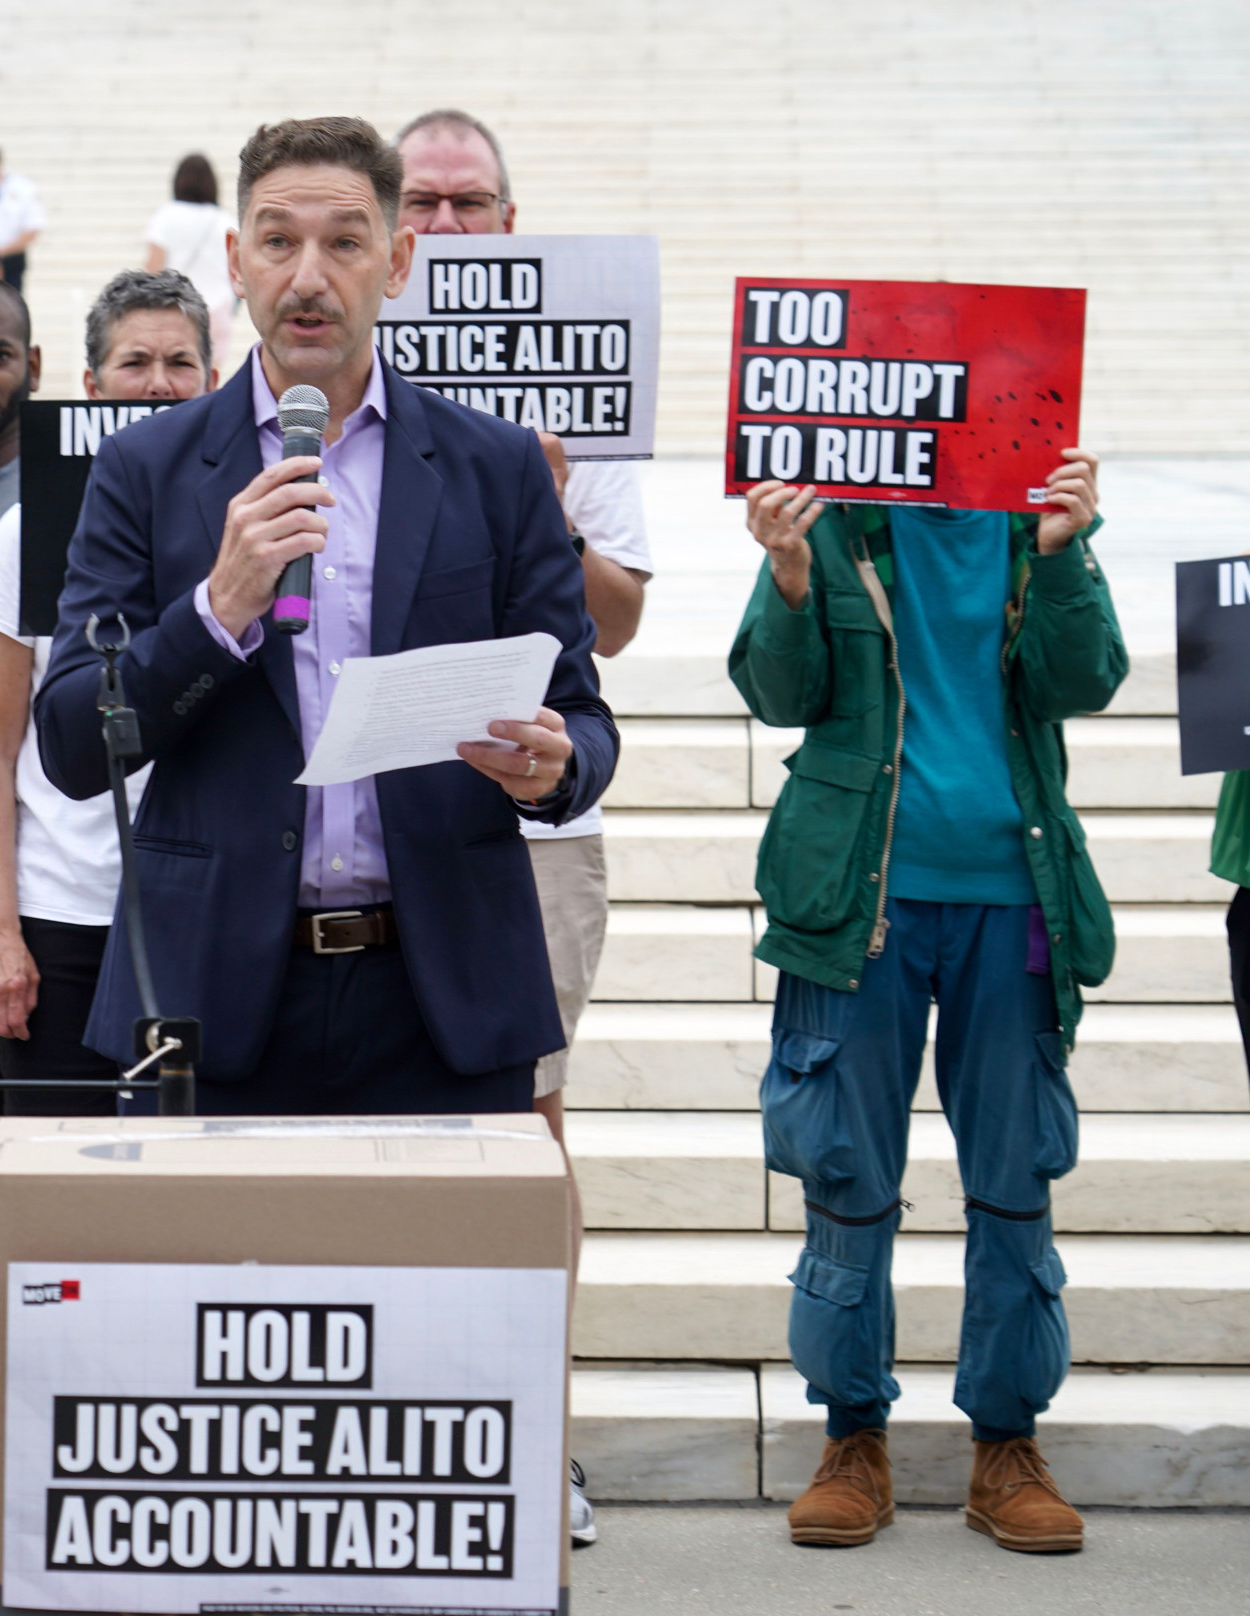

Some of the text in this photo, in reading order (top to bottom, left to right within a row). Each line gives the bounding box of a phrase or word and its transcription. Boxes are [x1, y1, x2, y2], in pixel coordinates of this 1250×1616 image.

[433, 263, 538, 310] HOLD
[372, 324, 626, 372] USTICE ALITO
[749, 290, 843, 346] TOO
[745, 358, 965, 419] CORRUPT
[740, 424, 933, 487] TO RULE
[203, 1310, 366, 1382] HOLD
[58, 1403, 505, 1478] JUSTICE ALITO
[51, 1495, 506, 1572] ACCOUNTABLE!
